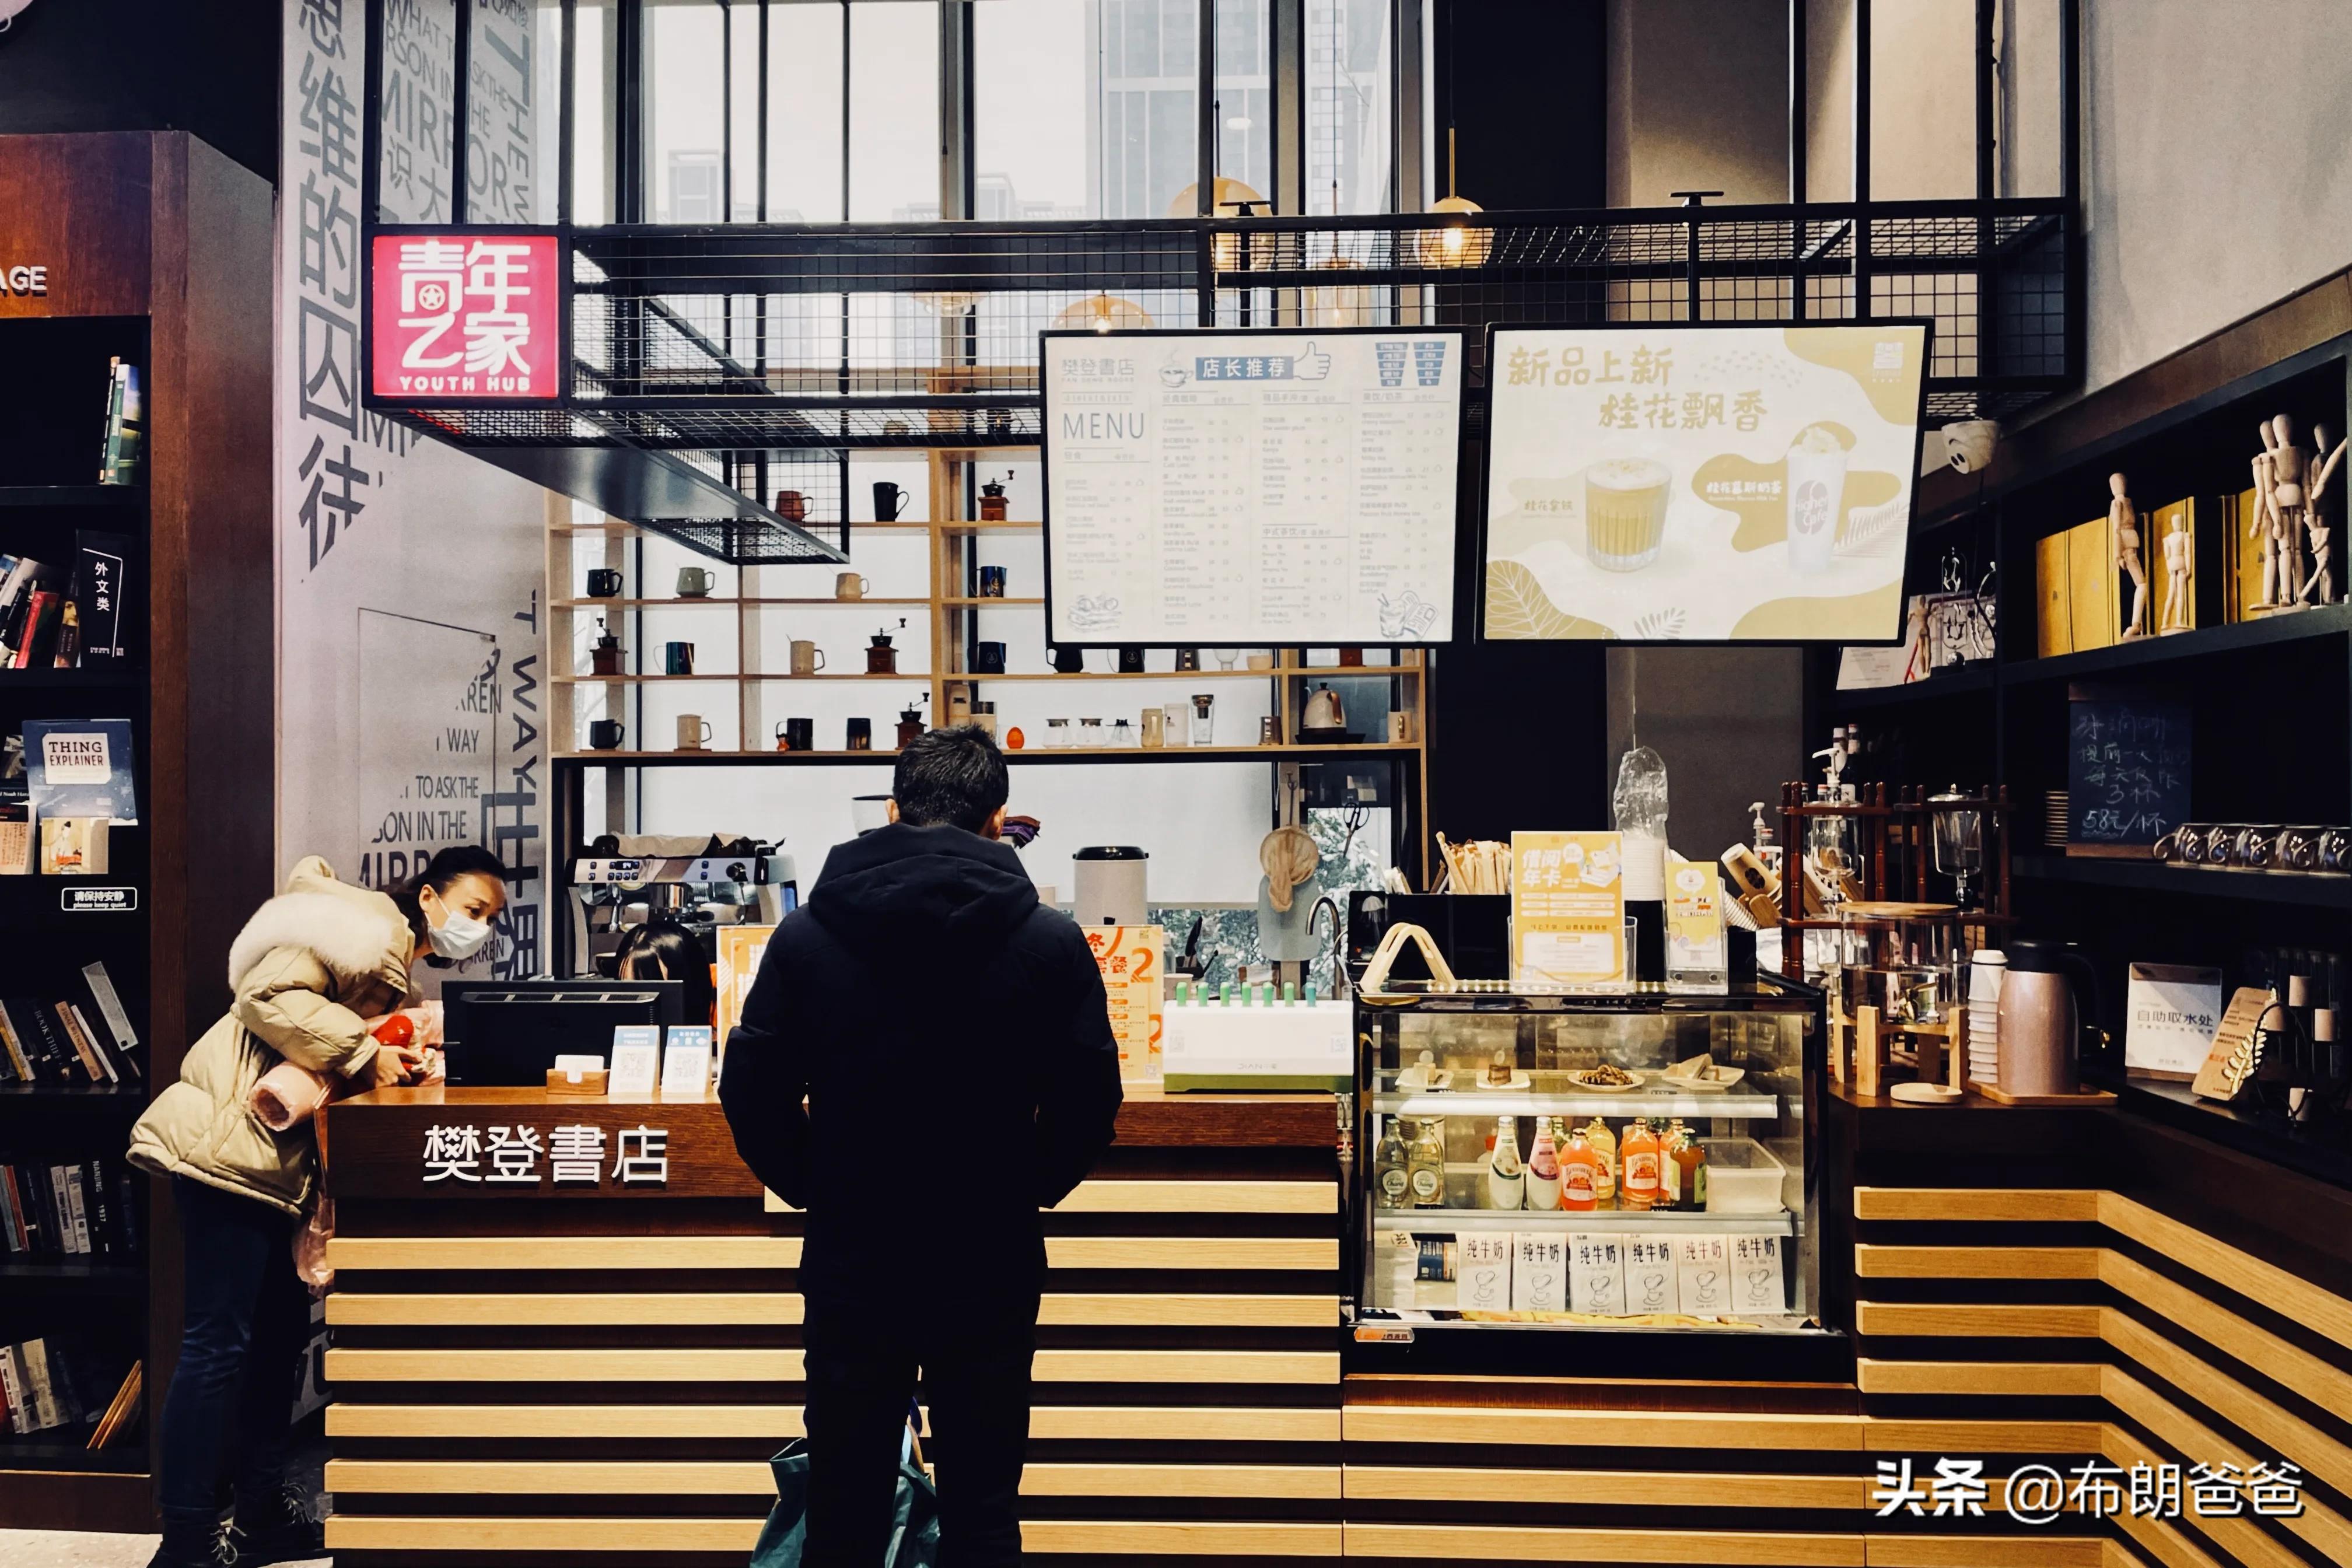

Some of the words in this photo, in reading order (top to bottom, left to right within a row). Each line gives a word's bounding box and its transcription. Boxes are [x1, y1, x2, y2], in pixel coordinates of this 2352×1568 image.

[1202, 357, 1285, 379] 店长推荐
[1507, 343, 1675, 387] 新品上新
[400, 376, 475, 391] YOUTH
[487, 376, 531, 391] HUB
[1598, 388, 1768, 432] 桂花飘香
[1063, 412, 1144, 439] MENU
[95, 562, 110, 611] 外文类
[512, 655, 538, 790] WAY
[48, 741, 103, 753] THING
[446, 727, 480, 754] WAY
[50, 754, 104, 766] EXPLAINER
[415, 776, 435, 799] TO
[459, 775, 480, 799] THE
[417, 811, 434, 841] IN
[438, 810, 467, 840] THE
[1130, 947, 1154, 984] 2
[34, 1010, 51, 1035] BOOK
[2137, 1010, 2214, 1027] 自助取水处
[422, 1124, 668, 1183] 樊登書店
[98, 1204, 107, 1223] 1937
[1467, 1237, 1503, 1261] 纯牛奶
[1523, 1241, 1560, 1264] 纯牛奶
[1580, 1244, 1616, 1265] 纯牛奶
[1633, 1242, 1669, 1263] 纯牛奶
[1686, 1239, 1721, 1259] 纯牛奶
[1737, 1237, 1775, 1258] 纯牛奶
